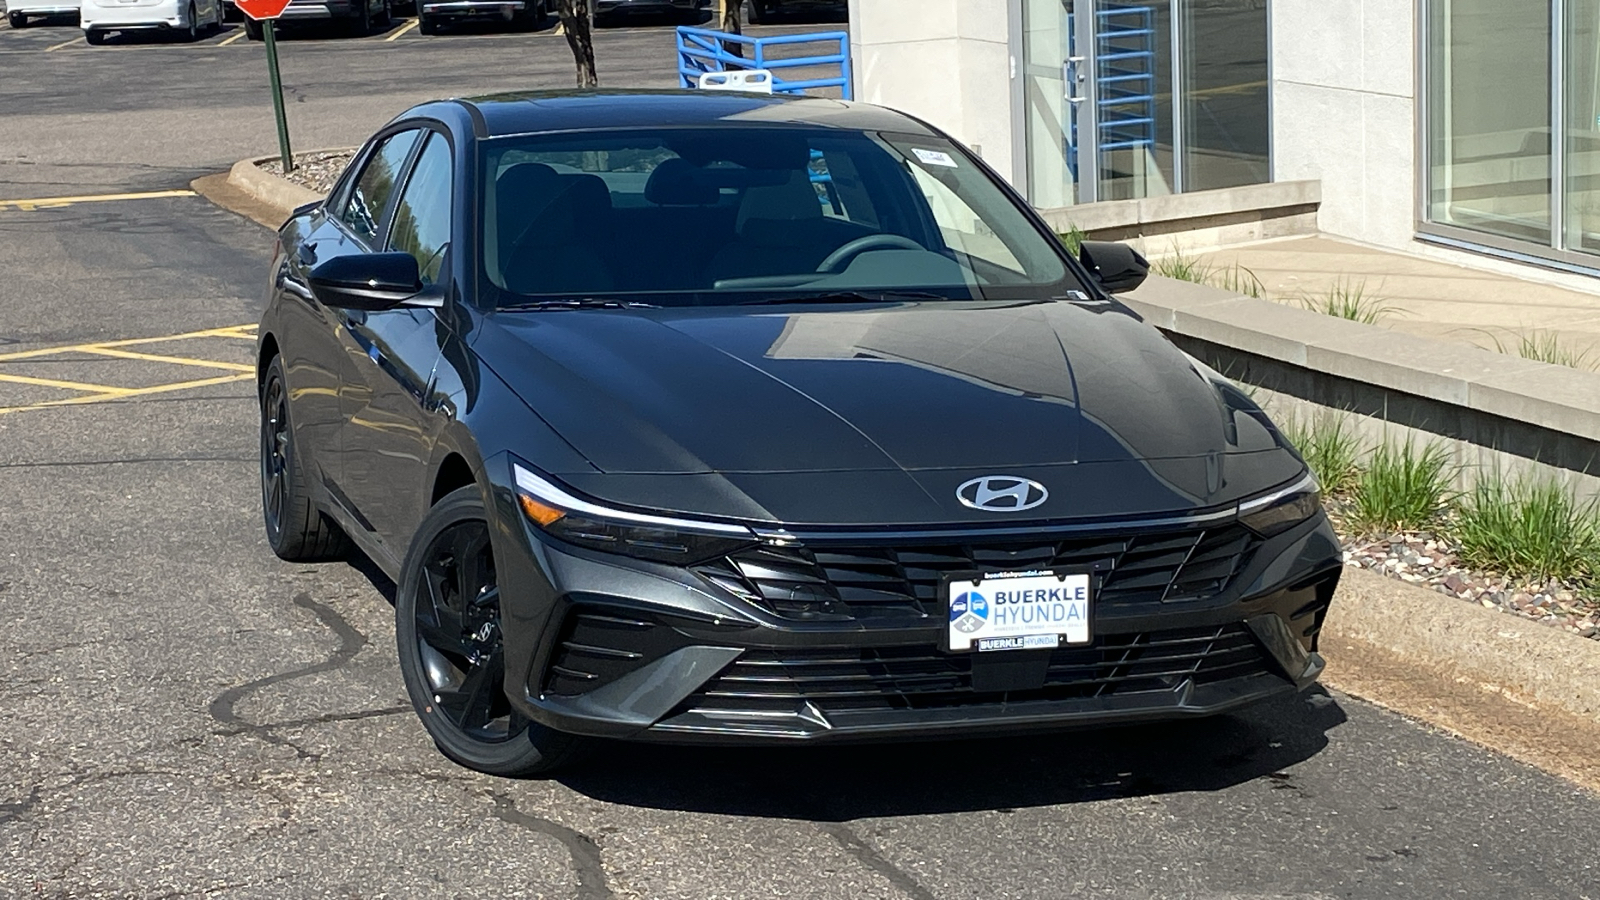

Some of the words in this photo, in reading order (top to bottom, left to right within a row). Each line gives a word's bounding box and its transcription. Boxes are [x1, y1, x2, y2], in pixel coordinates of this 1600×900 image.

[995, 587, 1086, 605] BUERKLE
[994, 603, 1086, 625] HYUNDAI
[980, 637, 1024, 650] BUERKLE
[1024, 635, 1057, 647] HYUNDAI
